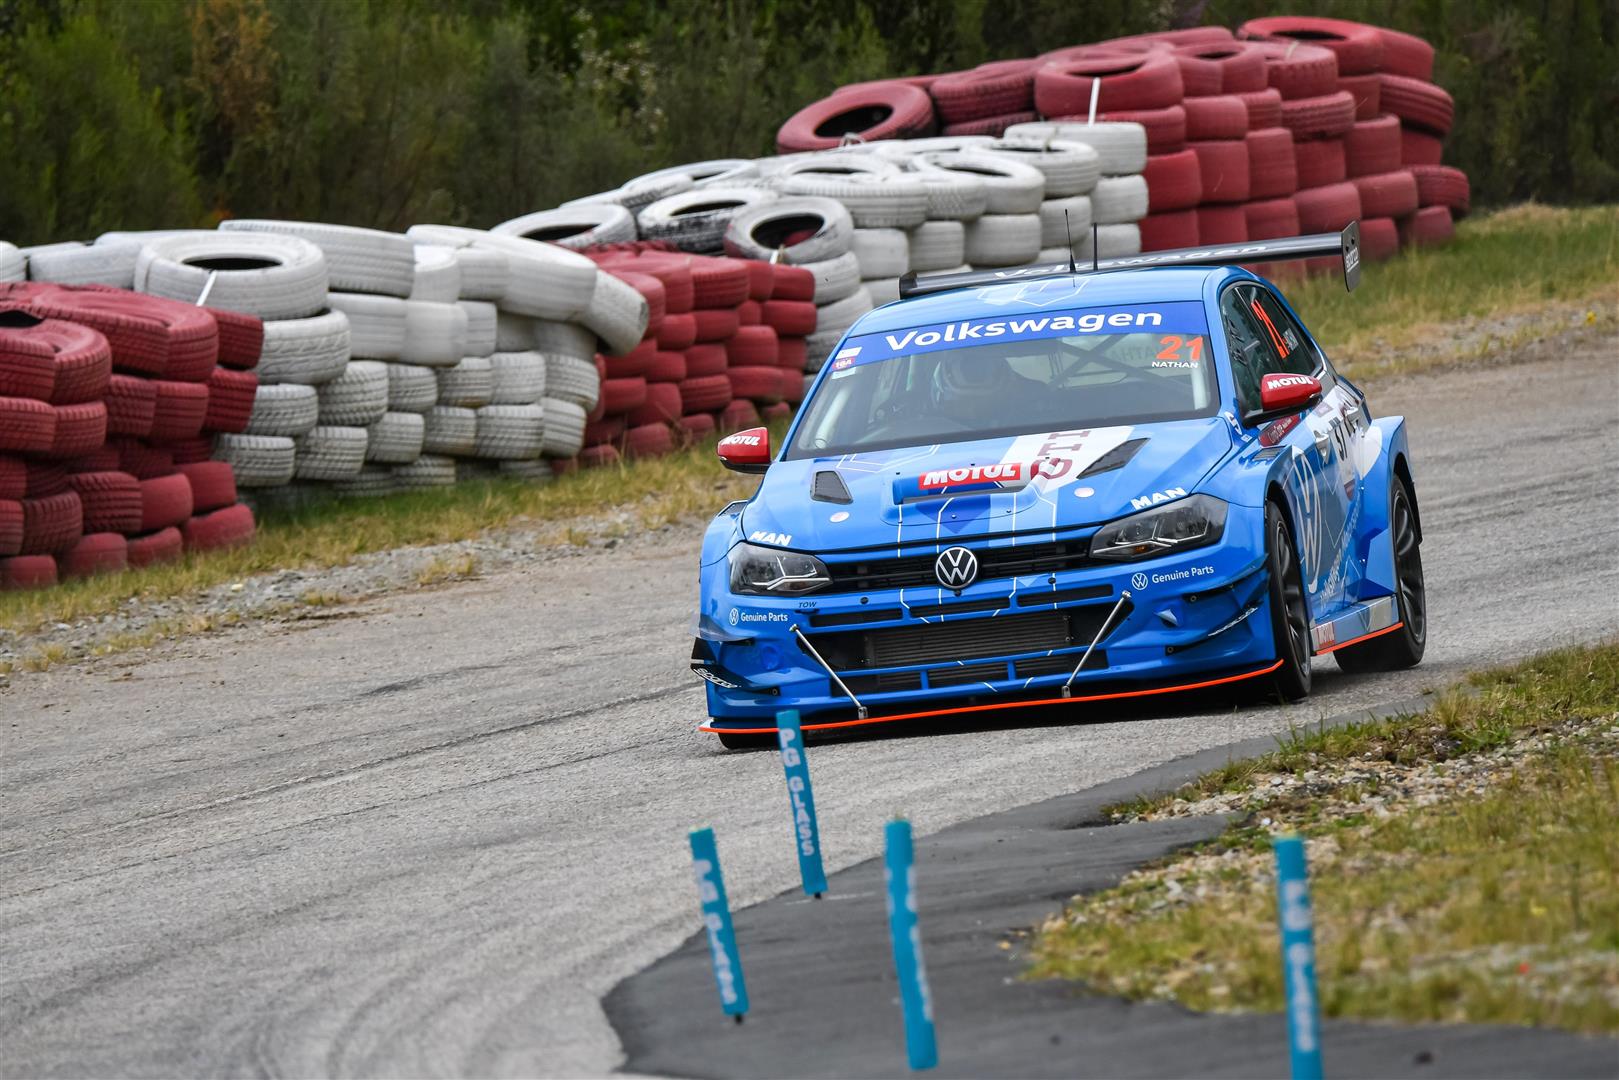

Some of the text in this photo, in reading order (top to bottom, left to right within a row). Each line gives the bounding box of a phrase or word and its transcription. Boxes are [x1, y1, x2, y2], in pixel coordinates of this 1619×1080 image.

[885, 312, 1162, 351] Volkswagen
[1156, 335, 1204, 362] 21
[1151, 361, 1199, 369] NATHAN
[1266, 376, 1314, 390] MOTUL
[720, 435, 761, 446] MOTUL
[923, 463, 1017, 486] MOTUL
[1130, 487, 1187, 511] MAN
[748, 531, 793, 547] MAN
[1151, 568, 1190, 584] Genuine
[1191, 565, 1215, 577] Parts
[798, 601, 818, 609] TOW
[740, 612, 768, 622] Genuine
[768, 612, 789, 622] Parts
[779, 728, 815, 856] PG GLASS
